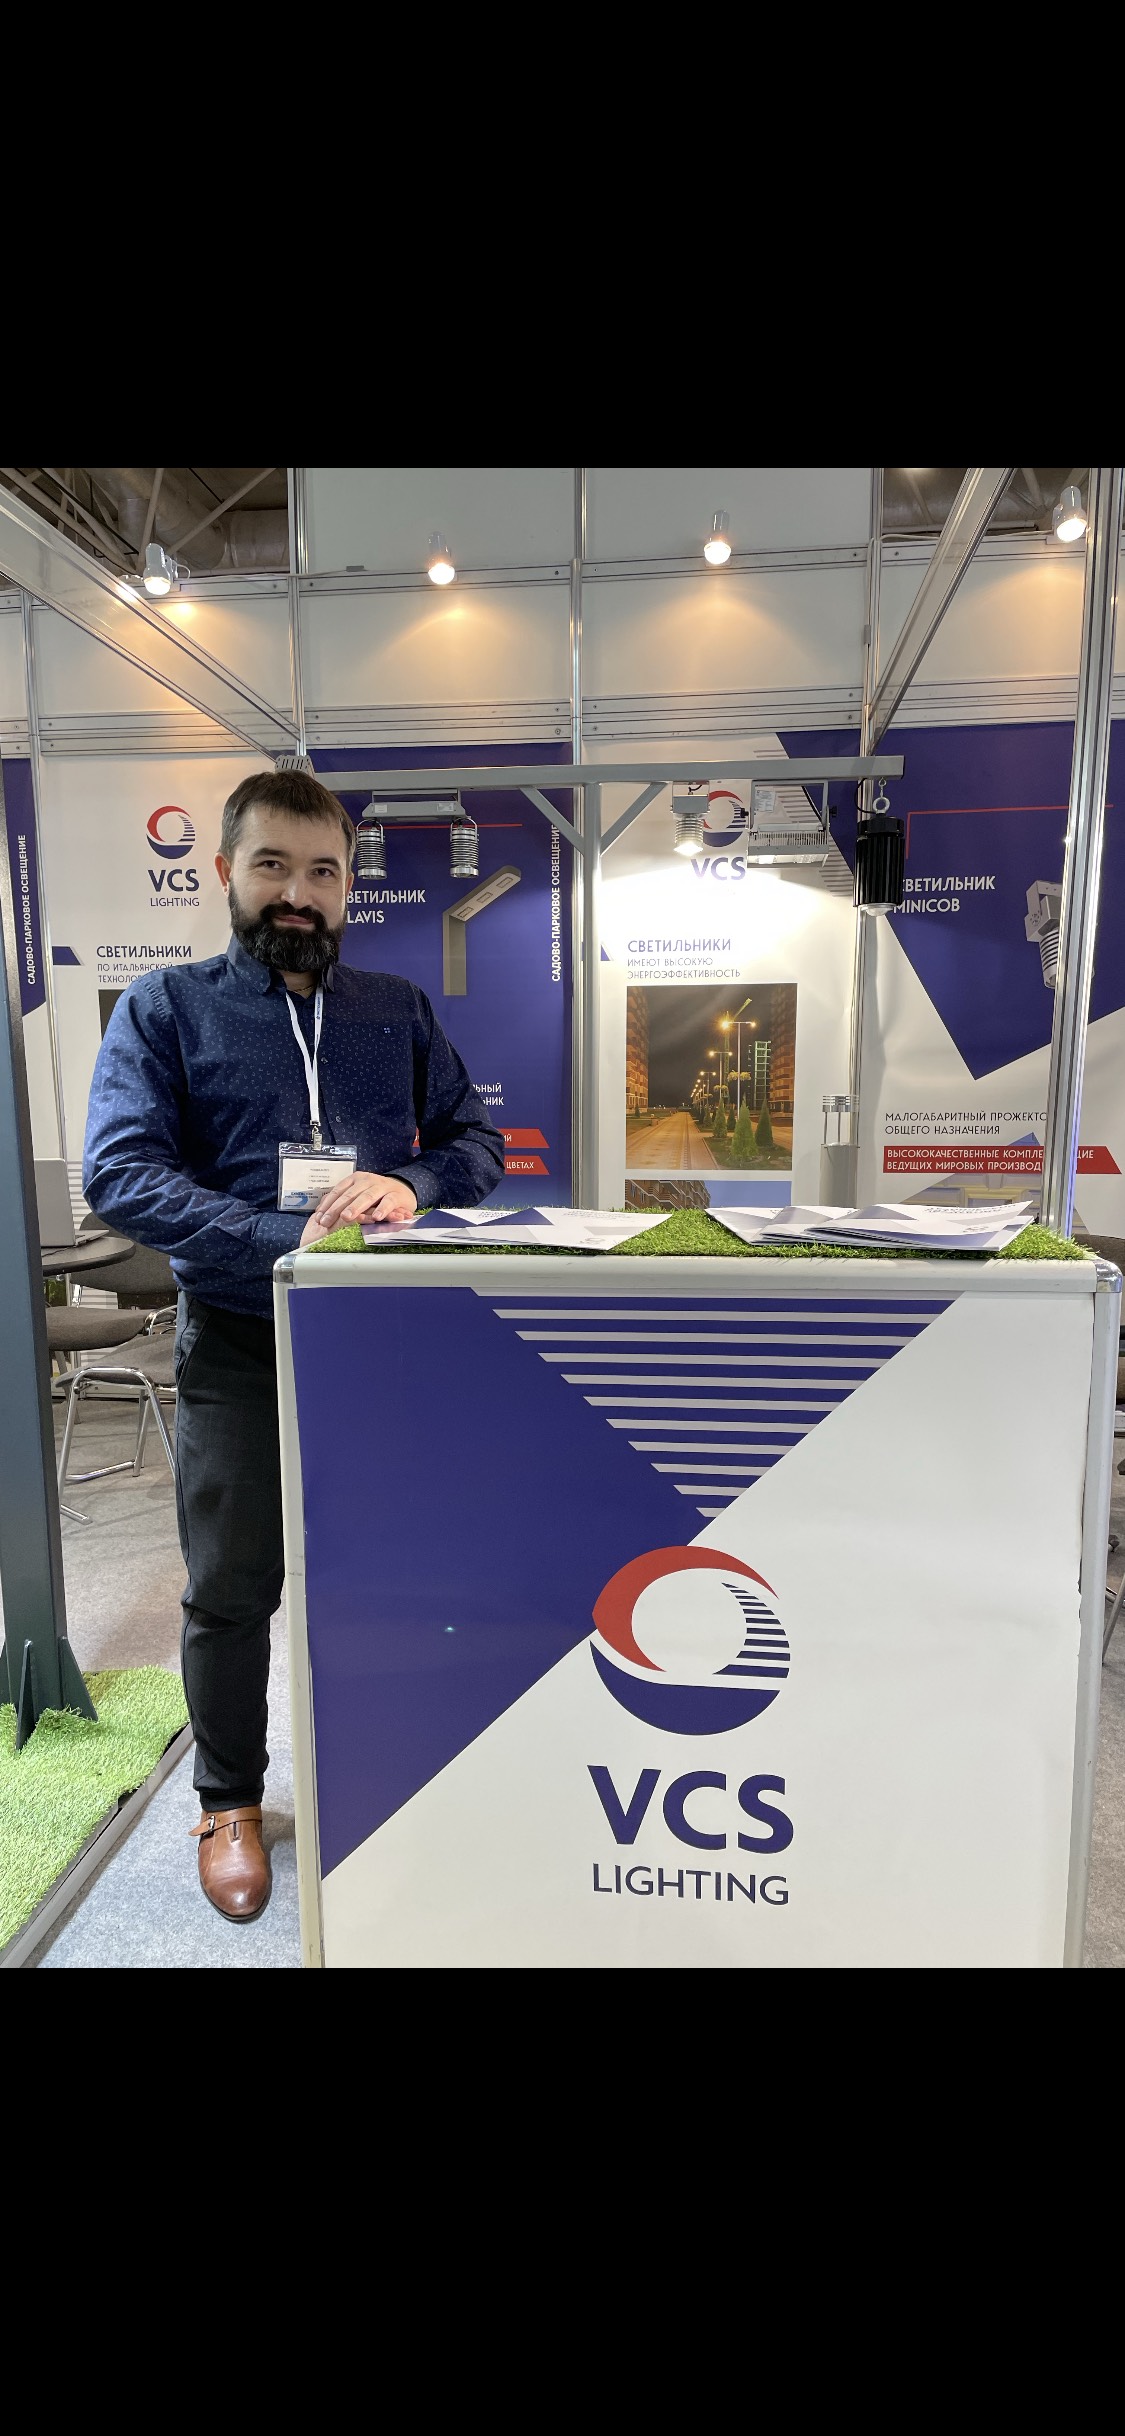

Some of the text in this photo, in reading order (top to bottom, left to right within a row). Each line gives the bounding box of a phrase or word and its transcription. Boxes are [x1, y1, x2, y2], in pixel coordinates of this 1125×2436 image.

[690, 856, 746, 881] VCS
[148, 869, 200, 892] VCS
[902, 875, 996, 892] ВЕТИЛЬНИК
[150, 898, 200, 907] LIGHTING
[346, 889, 426, 904] ВЕТИЛЬНИК
[18, 834, 35, 985] САДОВО-ПАРКОВОЕ ОСВЕЩЕНИЕ
[893, 897, 960, 913] MINICOB
[551, 887, 562, 982] САДОВО-ПАРКОВОЕ
[96, 945, 192, 958] СВЕТИЛЬНИКИ
[627, 938, 731, 952] СВЕТИЛЬНИКИ
[97, 963, 110, 972] ПО
[627, 957, 714, 967] ИМЕЮТ ВЫСОКУЮ
[98, 975, 142, 983] ТЕХНОЛО
[627, 969, 740, 979] ЭНЕРГОЭФФЕКТИВНОСТЬ
[885, 1109, 1047, 1122] МАЛОГАБАРИТНЫЙ ПРОЖЕКТО
[885, 1126, 1000, 1136] ОБЩЕГО НАЗНАЧЕНИЯ
[887, 1149, 1000, 1158] ВЫСОКОКАЧЕСТВЕННЫЕ
[506, 1161, 534, 1169] ЦВЕТАХ
[887, 1161, 932, 1171] ВЕДУЩИХ
[935, 1161, 984, 1170] МИРОВЫХ
[587, 1764, 794, 1854] VCS
[593, 1863, 789, 1906] LIGHTING
